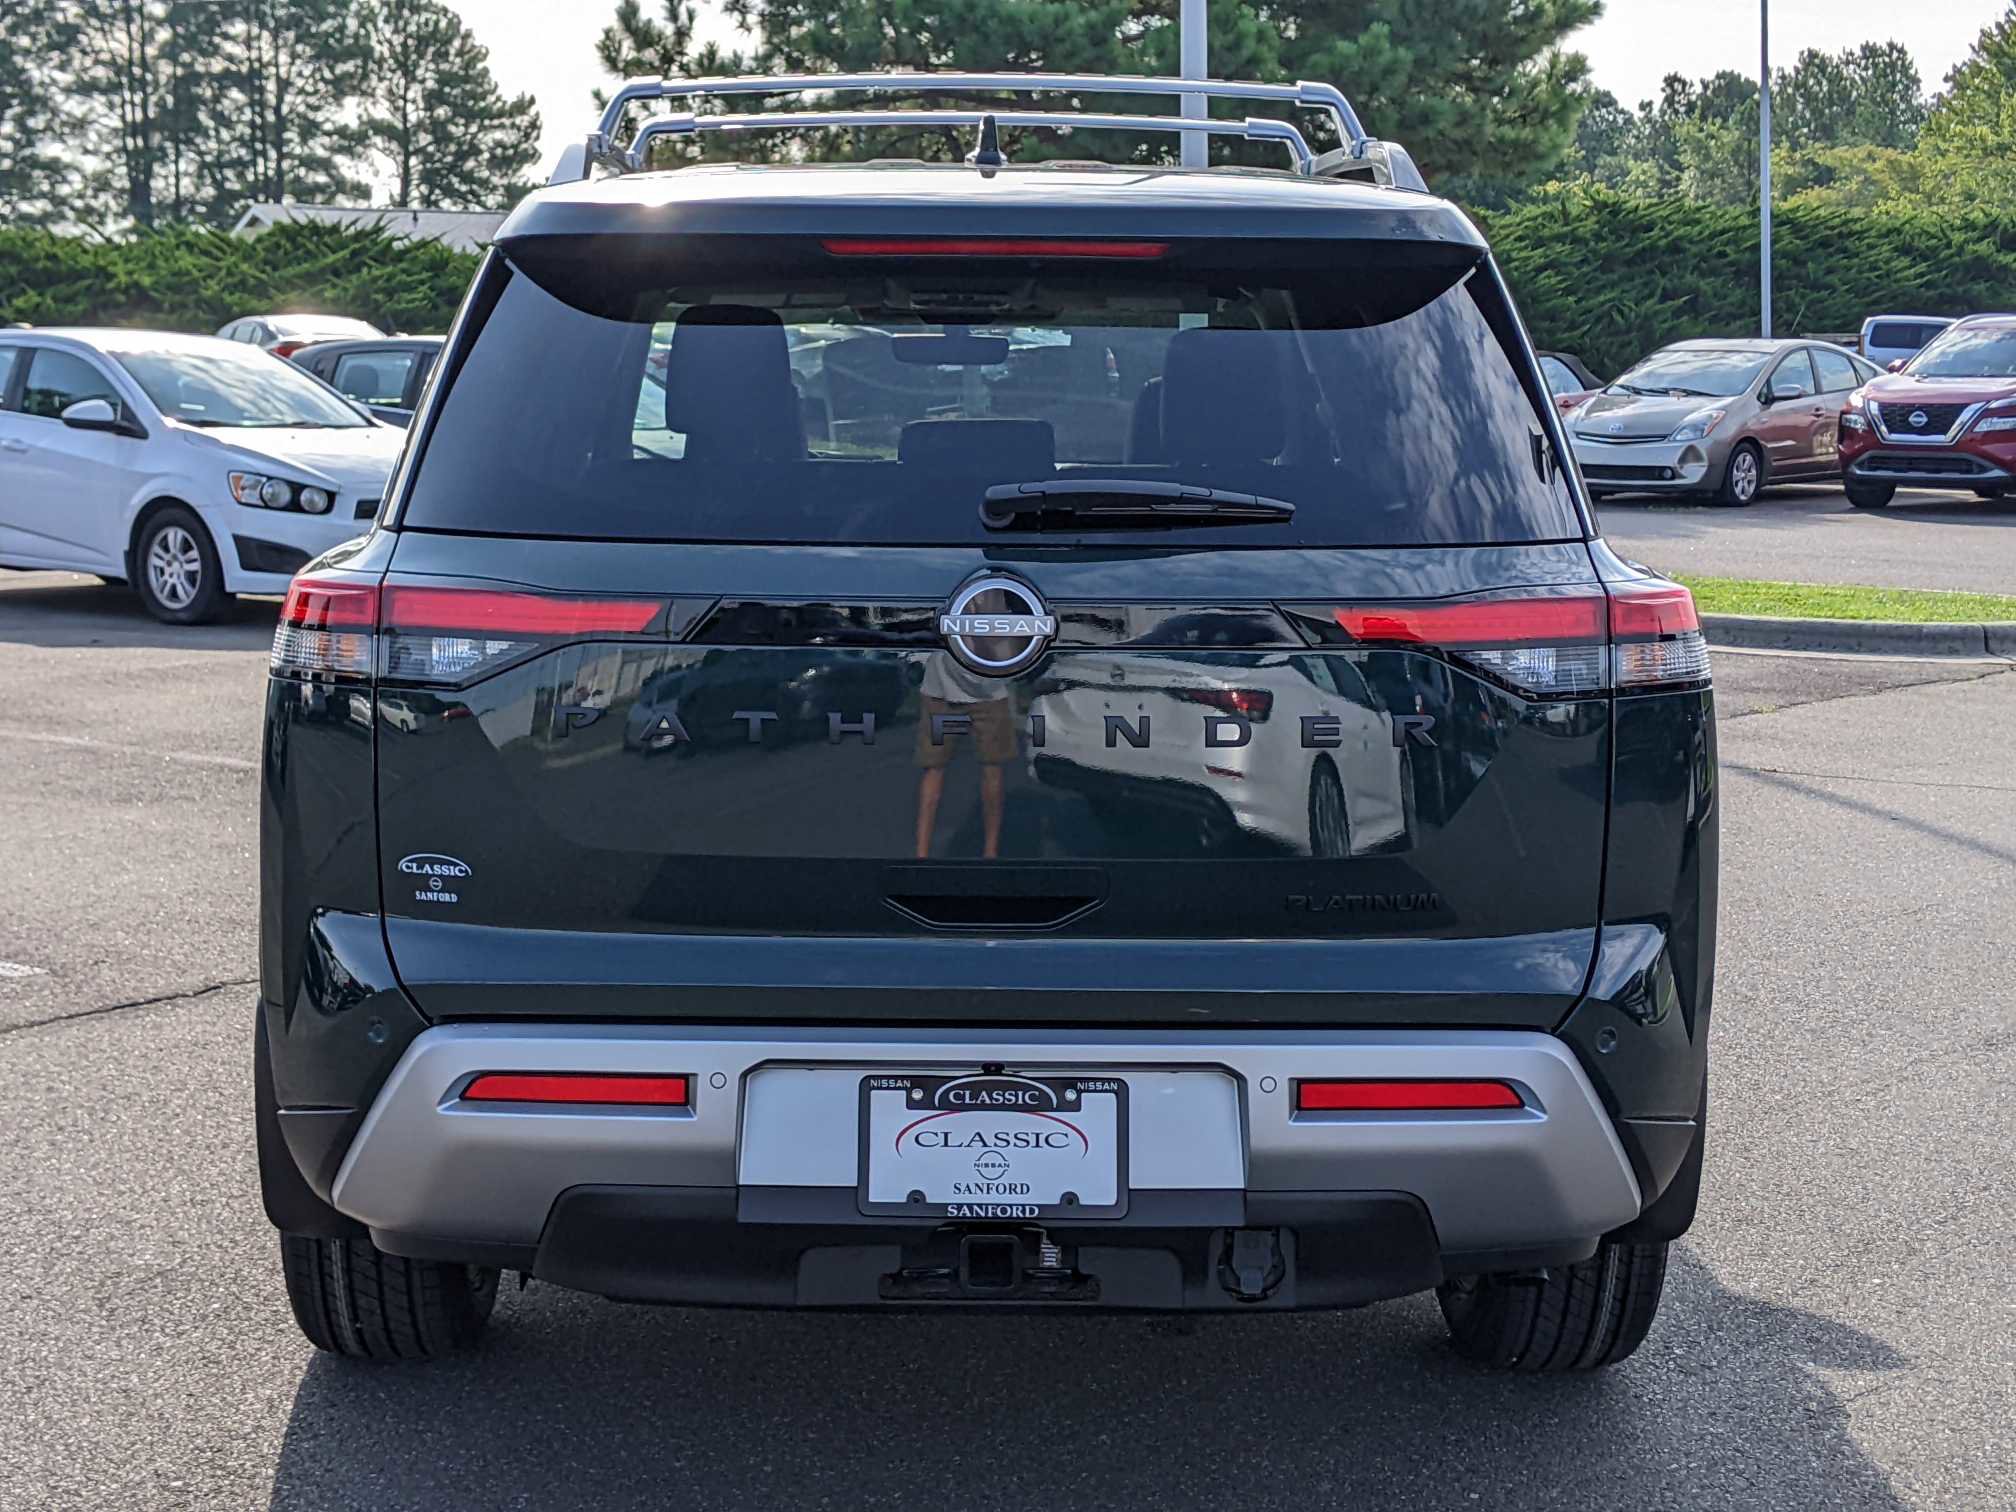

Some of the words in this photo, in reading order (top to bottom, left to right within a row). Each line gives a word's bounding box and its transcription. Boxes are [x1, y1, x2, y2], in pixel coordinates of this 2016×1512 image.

[943, 618, 1051, 633] NISSAN
[554, 704, 1438, 748] PATHFINDER
[402, 862, 466, 877] CLASSIC
[415, 890, 458, 903] SANFORD
[1286, 892, 1441, 912] PLATINUM
[870, 1079, 911, 1088] NISSAN
[1077, 1081, 1118, 1091] NISSAN
[948, 1089, 1041, 1105] CLASSIC
[913, 1130, 1071, 1149] CLASSIC
[953, 1182, 1031, 1196] SANFORD
[947, 1204, 1040, 1218] SANFORD
